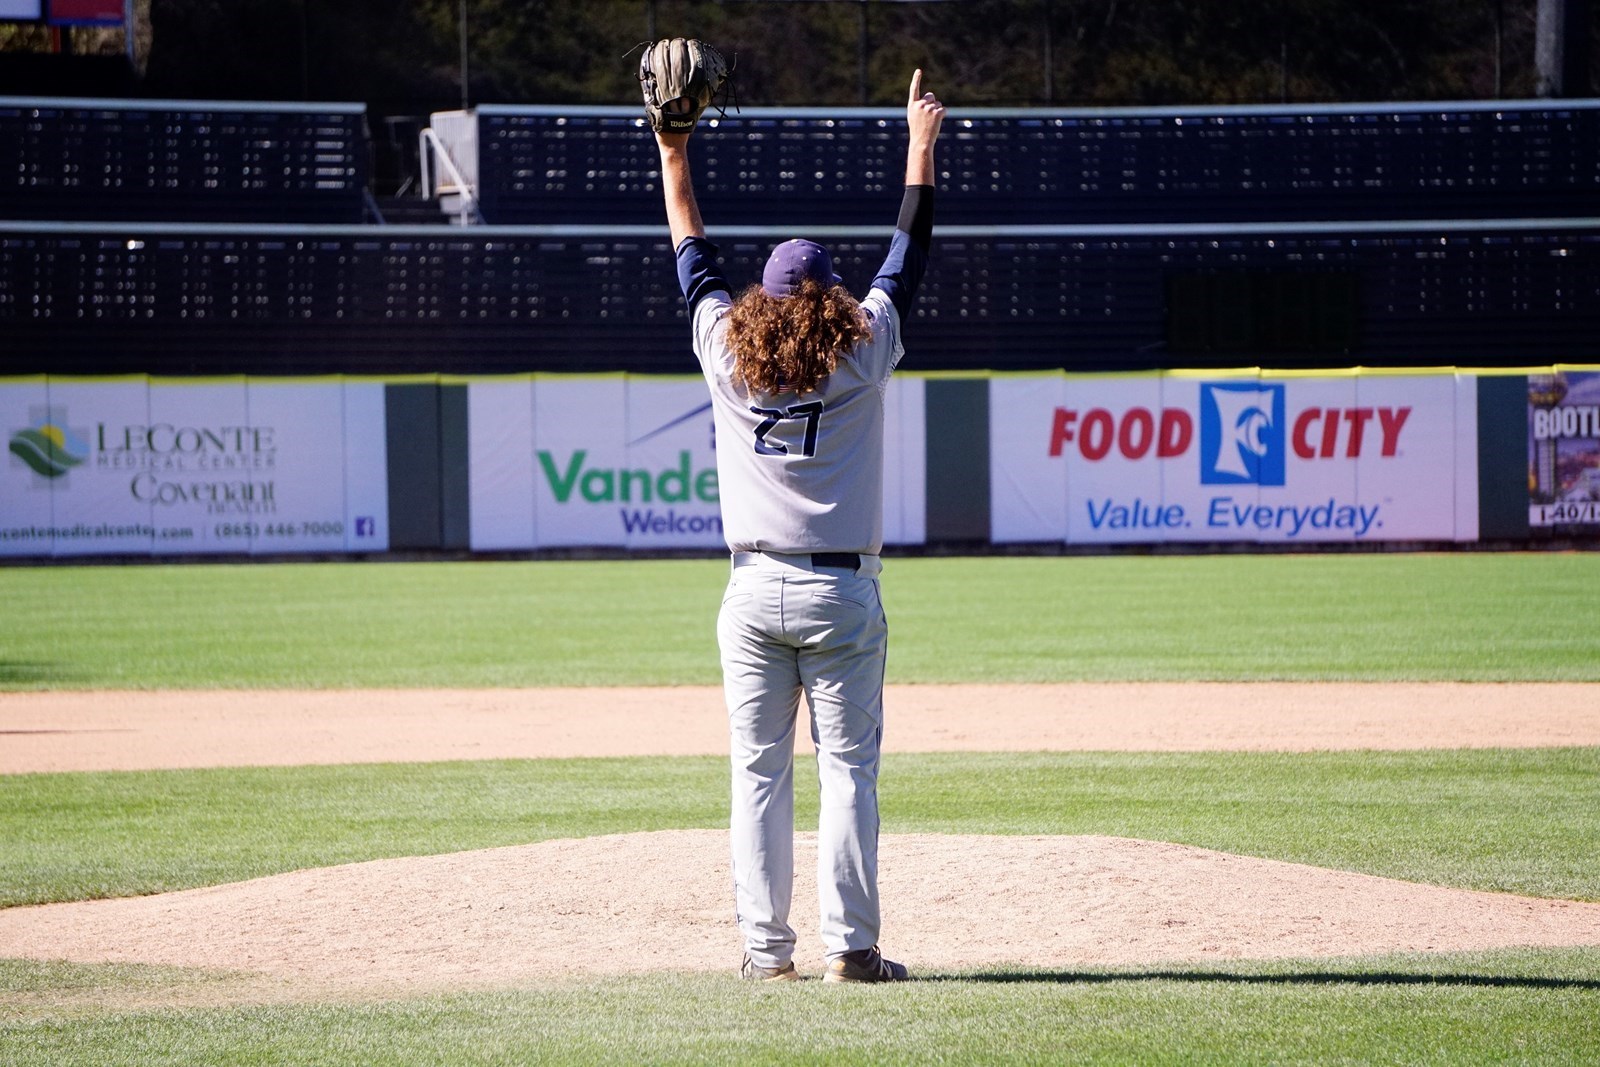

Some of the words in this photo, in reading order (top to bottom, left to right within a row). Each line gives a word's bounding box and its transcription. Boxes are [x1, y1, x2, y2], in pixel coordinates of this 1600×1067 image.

[748, 399, 825, 458] 27
[1048, 406, 1194, 461] FOOD
[1291, 406, 1413, 459] CITY
[97, 453, 184, 467] MEDICAL
[198, 453, 276, 467] CENTER
[131, 472, 275, 506] Covenant
[0, 523, 194, 540] contemedicalcenter.com
[214, 522, 259, 539] (865)
[265, 522, 344, 537] 446-7000
[1086, 498, 1191, 530] Value.
[1207, 497, 1385, 537] Everyday.
